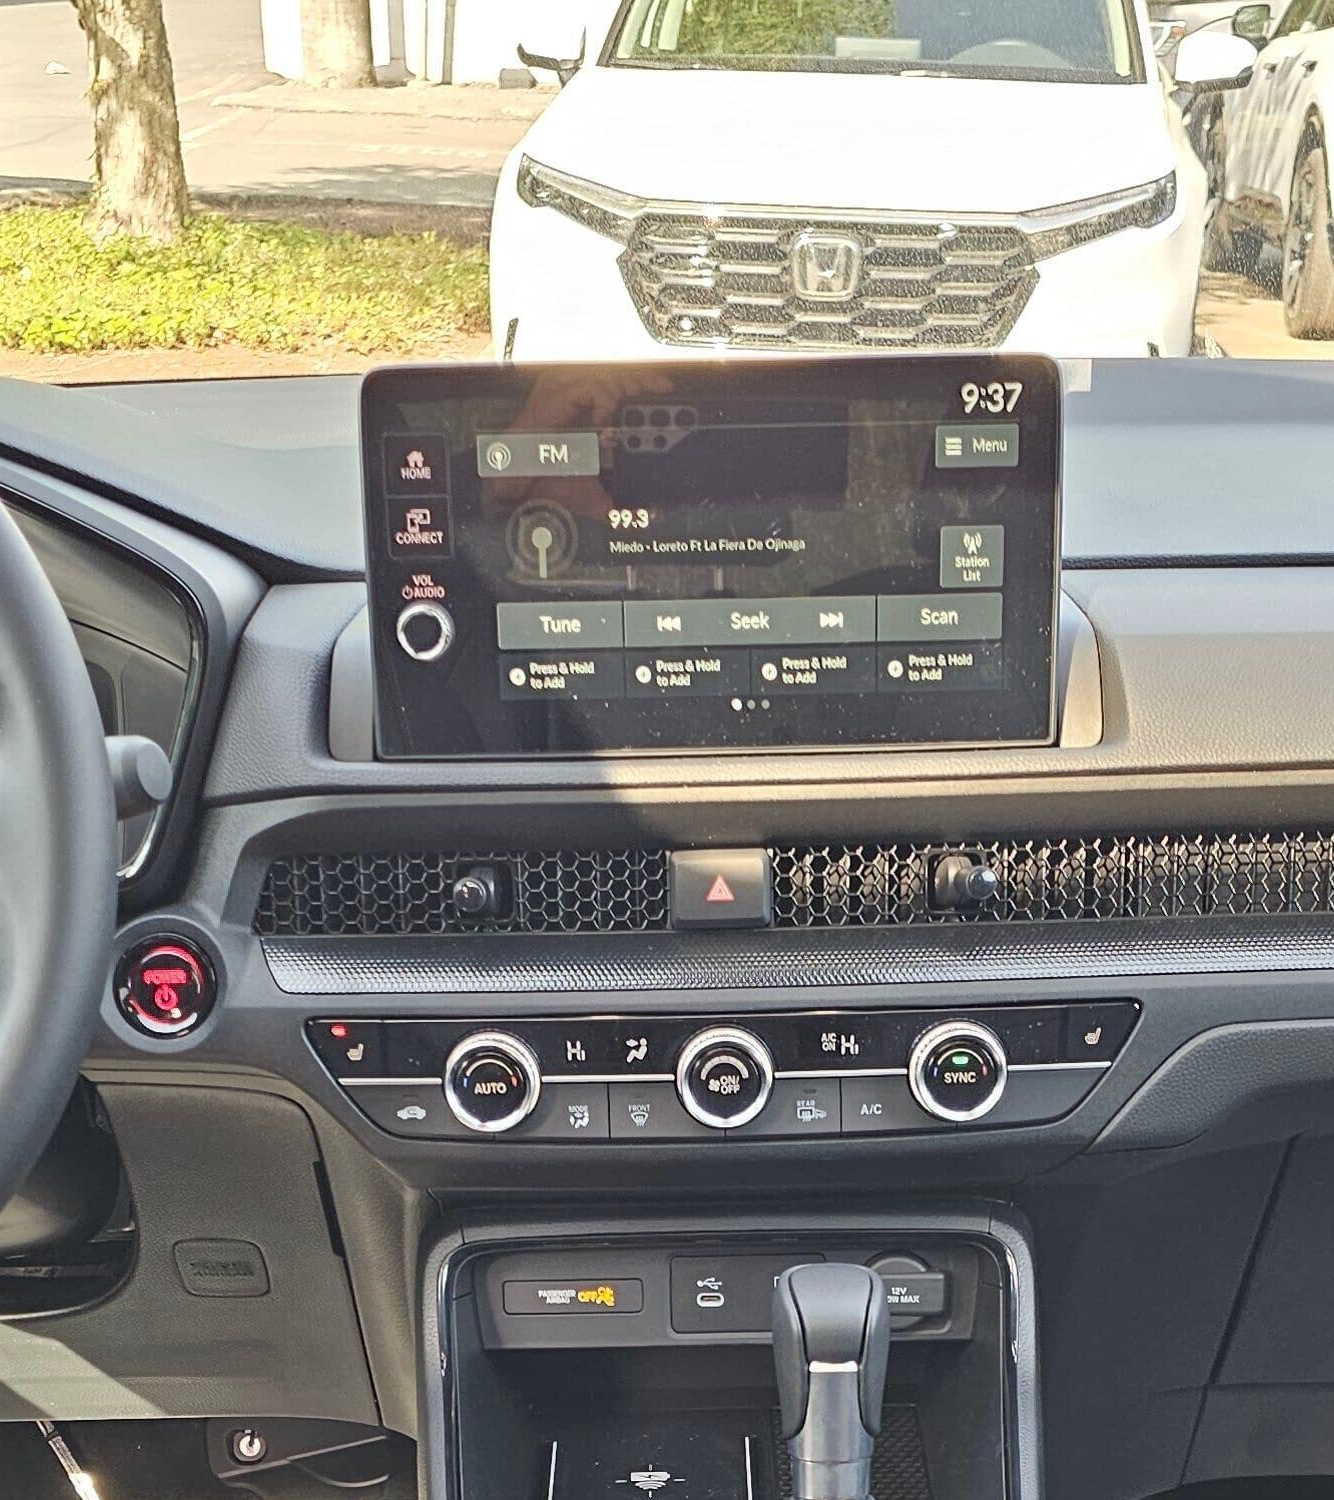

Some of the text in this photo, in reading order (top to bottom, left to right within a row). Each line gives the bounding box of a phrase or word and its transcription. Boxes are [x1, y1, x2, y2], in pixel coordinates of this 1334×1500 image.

[961, 382, 1023, 413] 9:37
[973, 437, 1007, 453] Menu
[539, 444, 569, 464] FM
[401, 467, 431, 479] HOME
[608, 508, 649, 529] 99.3
[395, 531, 443, 545] CONNECT
[610, 538, 806, 553] Miedo Loreto Ft La Fiera De Ojinaga
[955, 555, 990, 569] Station
[412, 575, 433, 586] VOL
[963, 569, 981, 582] List
[414, 586, 445, 598] AUDIO
[730, 611, 770, 630] Seek
[920, 608, 959, 626] Scan
[539, 616, 582, 633] Tune
[656, 659, 685, 672] Press
[696, 659, 721, 672] Hold
[782, 657, 810, 670] Press
[822, 656, 847, 669] Hold
[908, 654, 936, 667] Press
[947, 653, 973, 666] Hold
[529, 661, 558, 675] Press
[569, 661, 595, 674] Hold
[657, 674, 691, 687] to Add
[782, 672, 817, 684] to Add
[908, 669, 942, 681] to Add
[530, 676, 565, 689] to Add
[943, 1071, 976, 1084] SYNC
[474, 1082, 507, 1095] AUTO
[720, 1084, 740, 1095] OFF
[628, 1104, 650, 1112] FRONT
[860, 1104, 882, 1115] A/C
[890, 1286, 908, 1295] 12V
[900, 1295, 920, 1303] MAX
